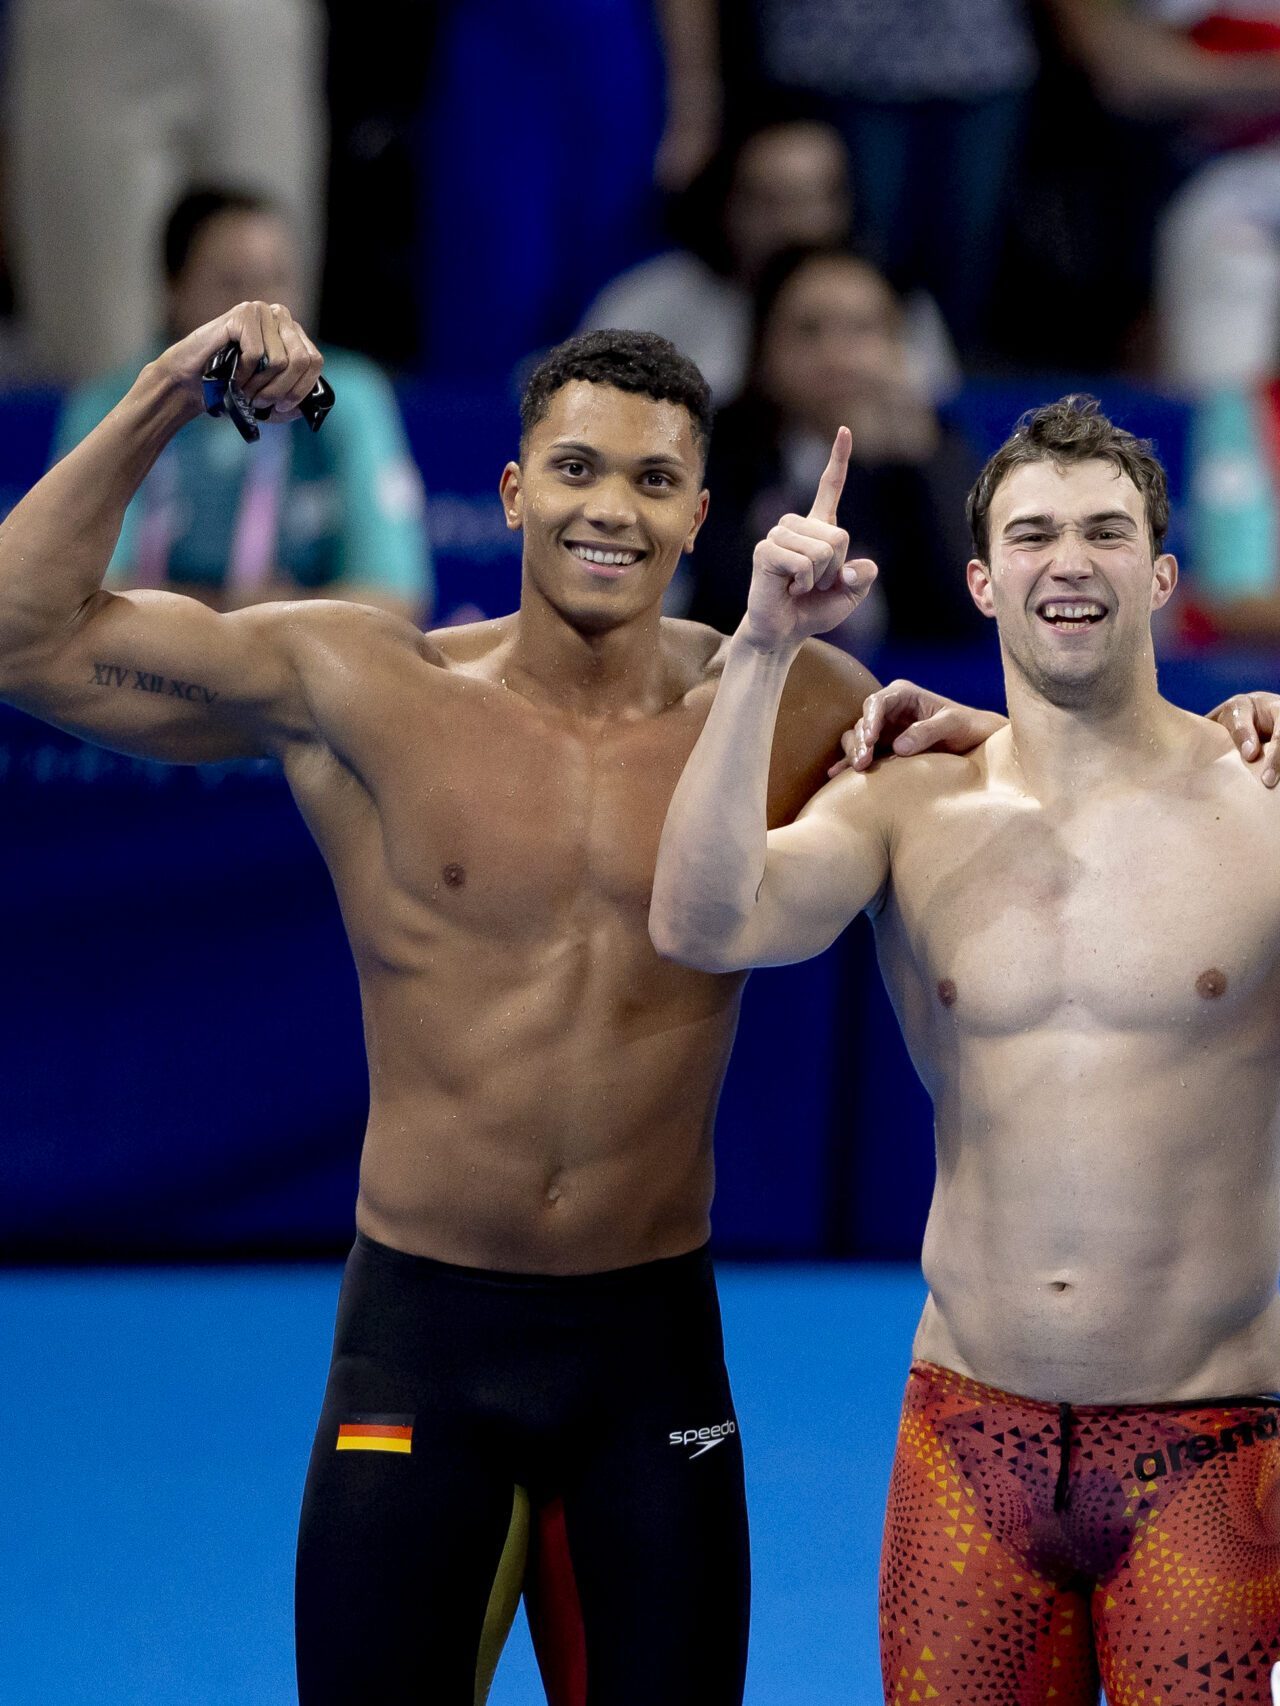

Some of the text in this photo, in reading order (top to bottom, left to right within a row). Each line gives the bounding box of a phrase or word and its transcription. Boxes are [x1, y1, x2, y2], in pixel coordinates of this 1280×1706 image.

[88, 663, 219, 704] XIV XII XCV
[669, 1420, 736, 1446] speedo
[1133, 1413, 1278, 1482] arena
